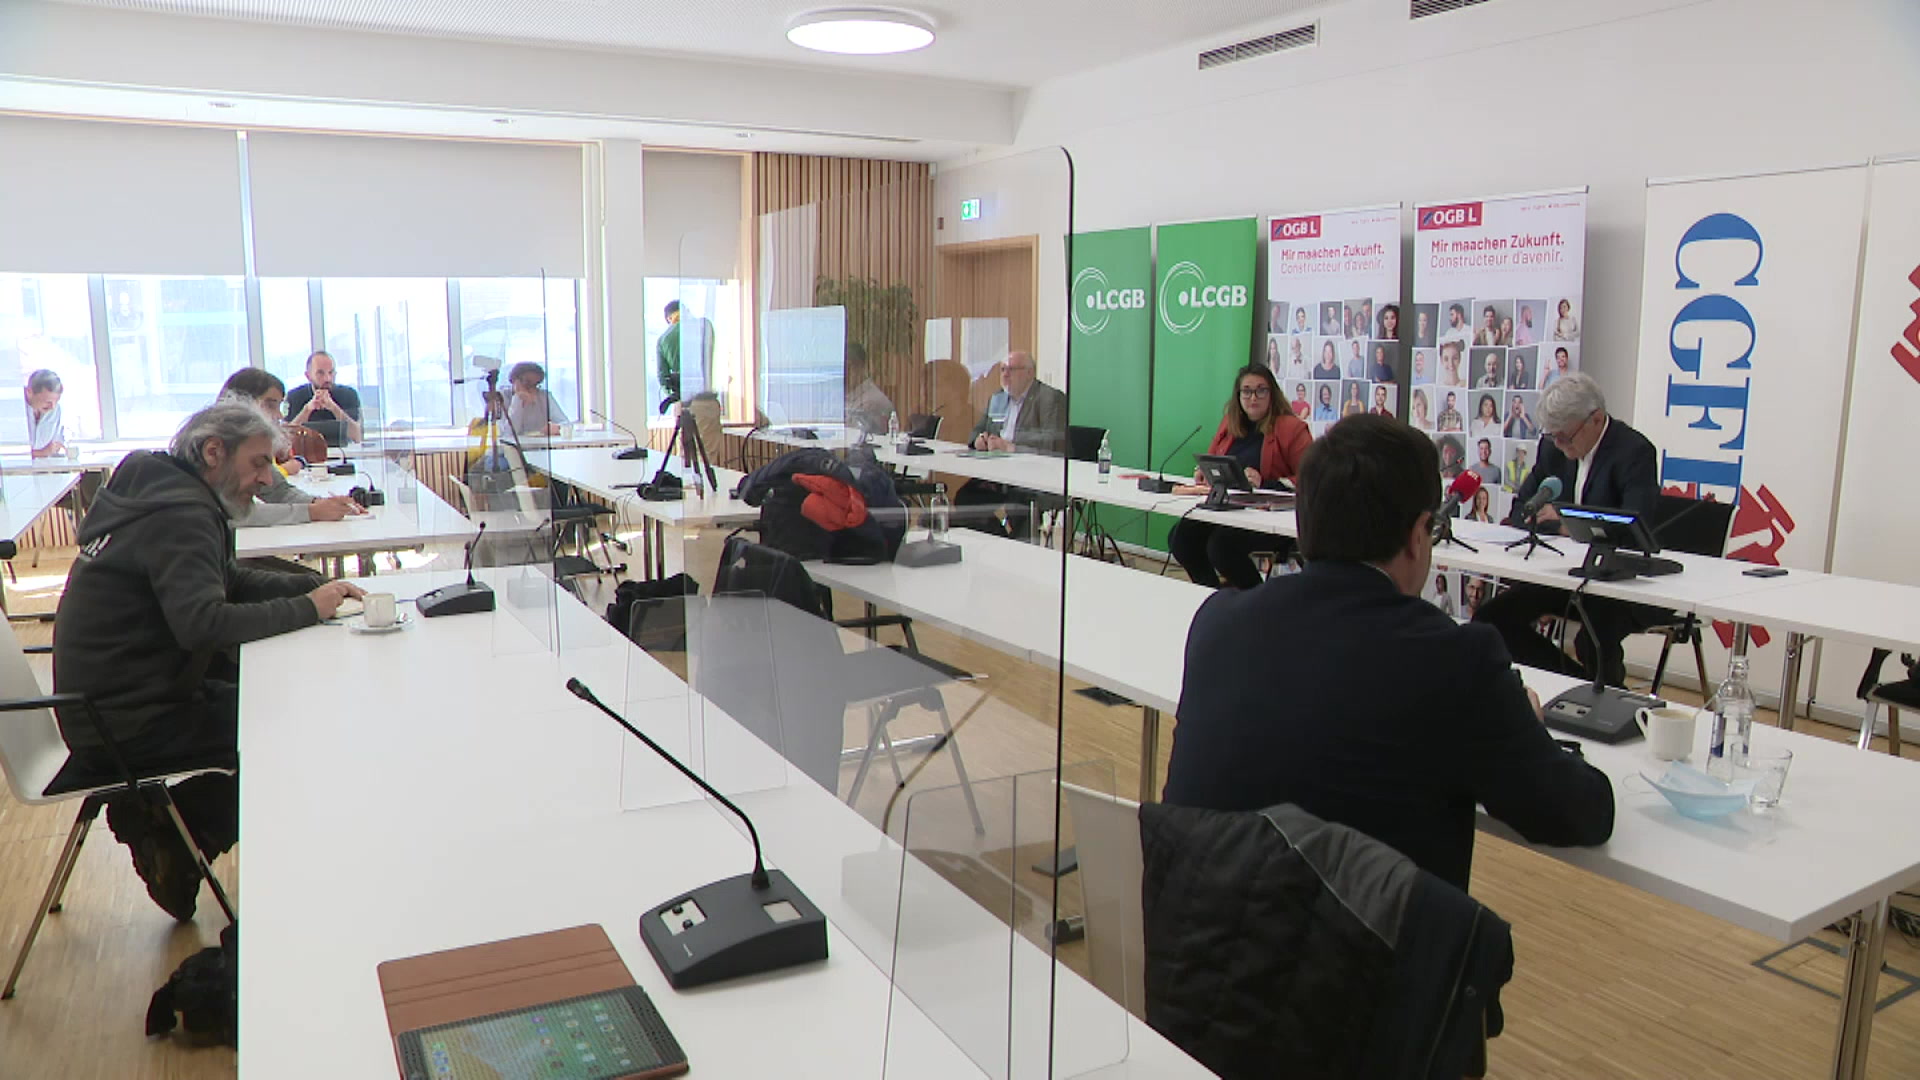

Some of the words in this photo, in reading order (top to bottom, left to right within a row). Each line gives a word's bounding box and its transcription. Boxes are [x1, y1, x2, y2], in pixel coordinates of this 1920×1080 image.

[1281, 248, 1296, 260] Mir
[1297, 246, 1341, 260] maachen
[1343, 243, 1385, 256] Zukunft.
[1431, 240, 1449, 253] Mir
[1451, 237, 1508, 253] maachen
[1511, 232, 1565, 248] Zukunft.
[1281, 261, 1341, 274] Constructeur
[1430, 253, 1508, 268] Constructeur
[1512, 249, 1564, 264] d'avenir.
[1096, 289, 1145, 310] LCGB
[1190, 285, 1247, 308] LCGB
